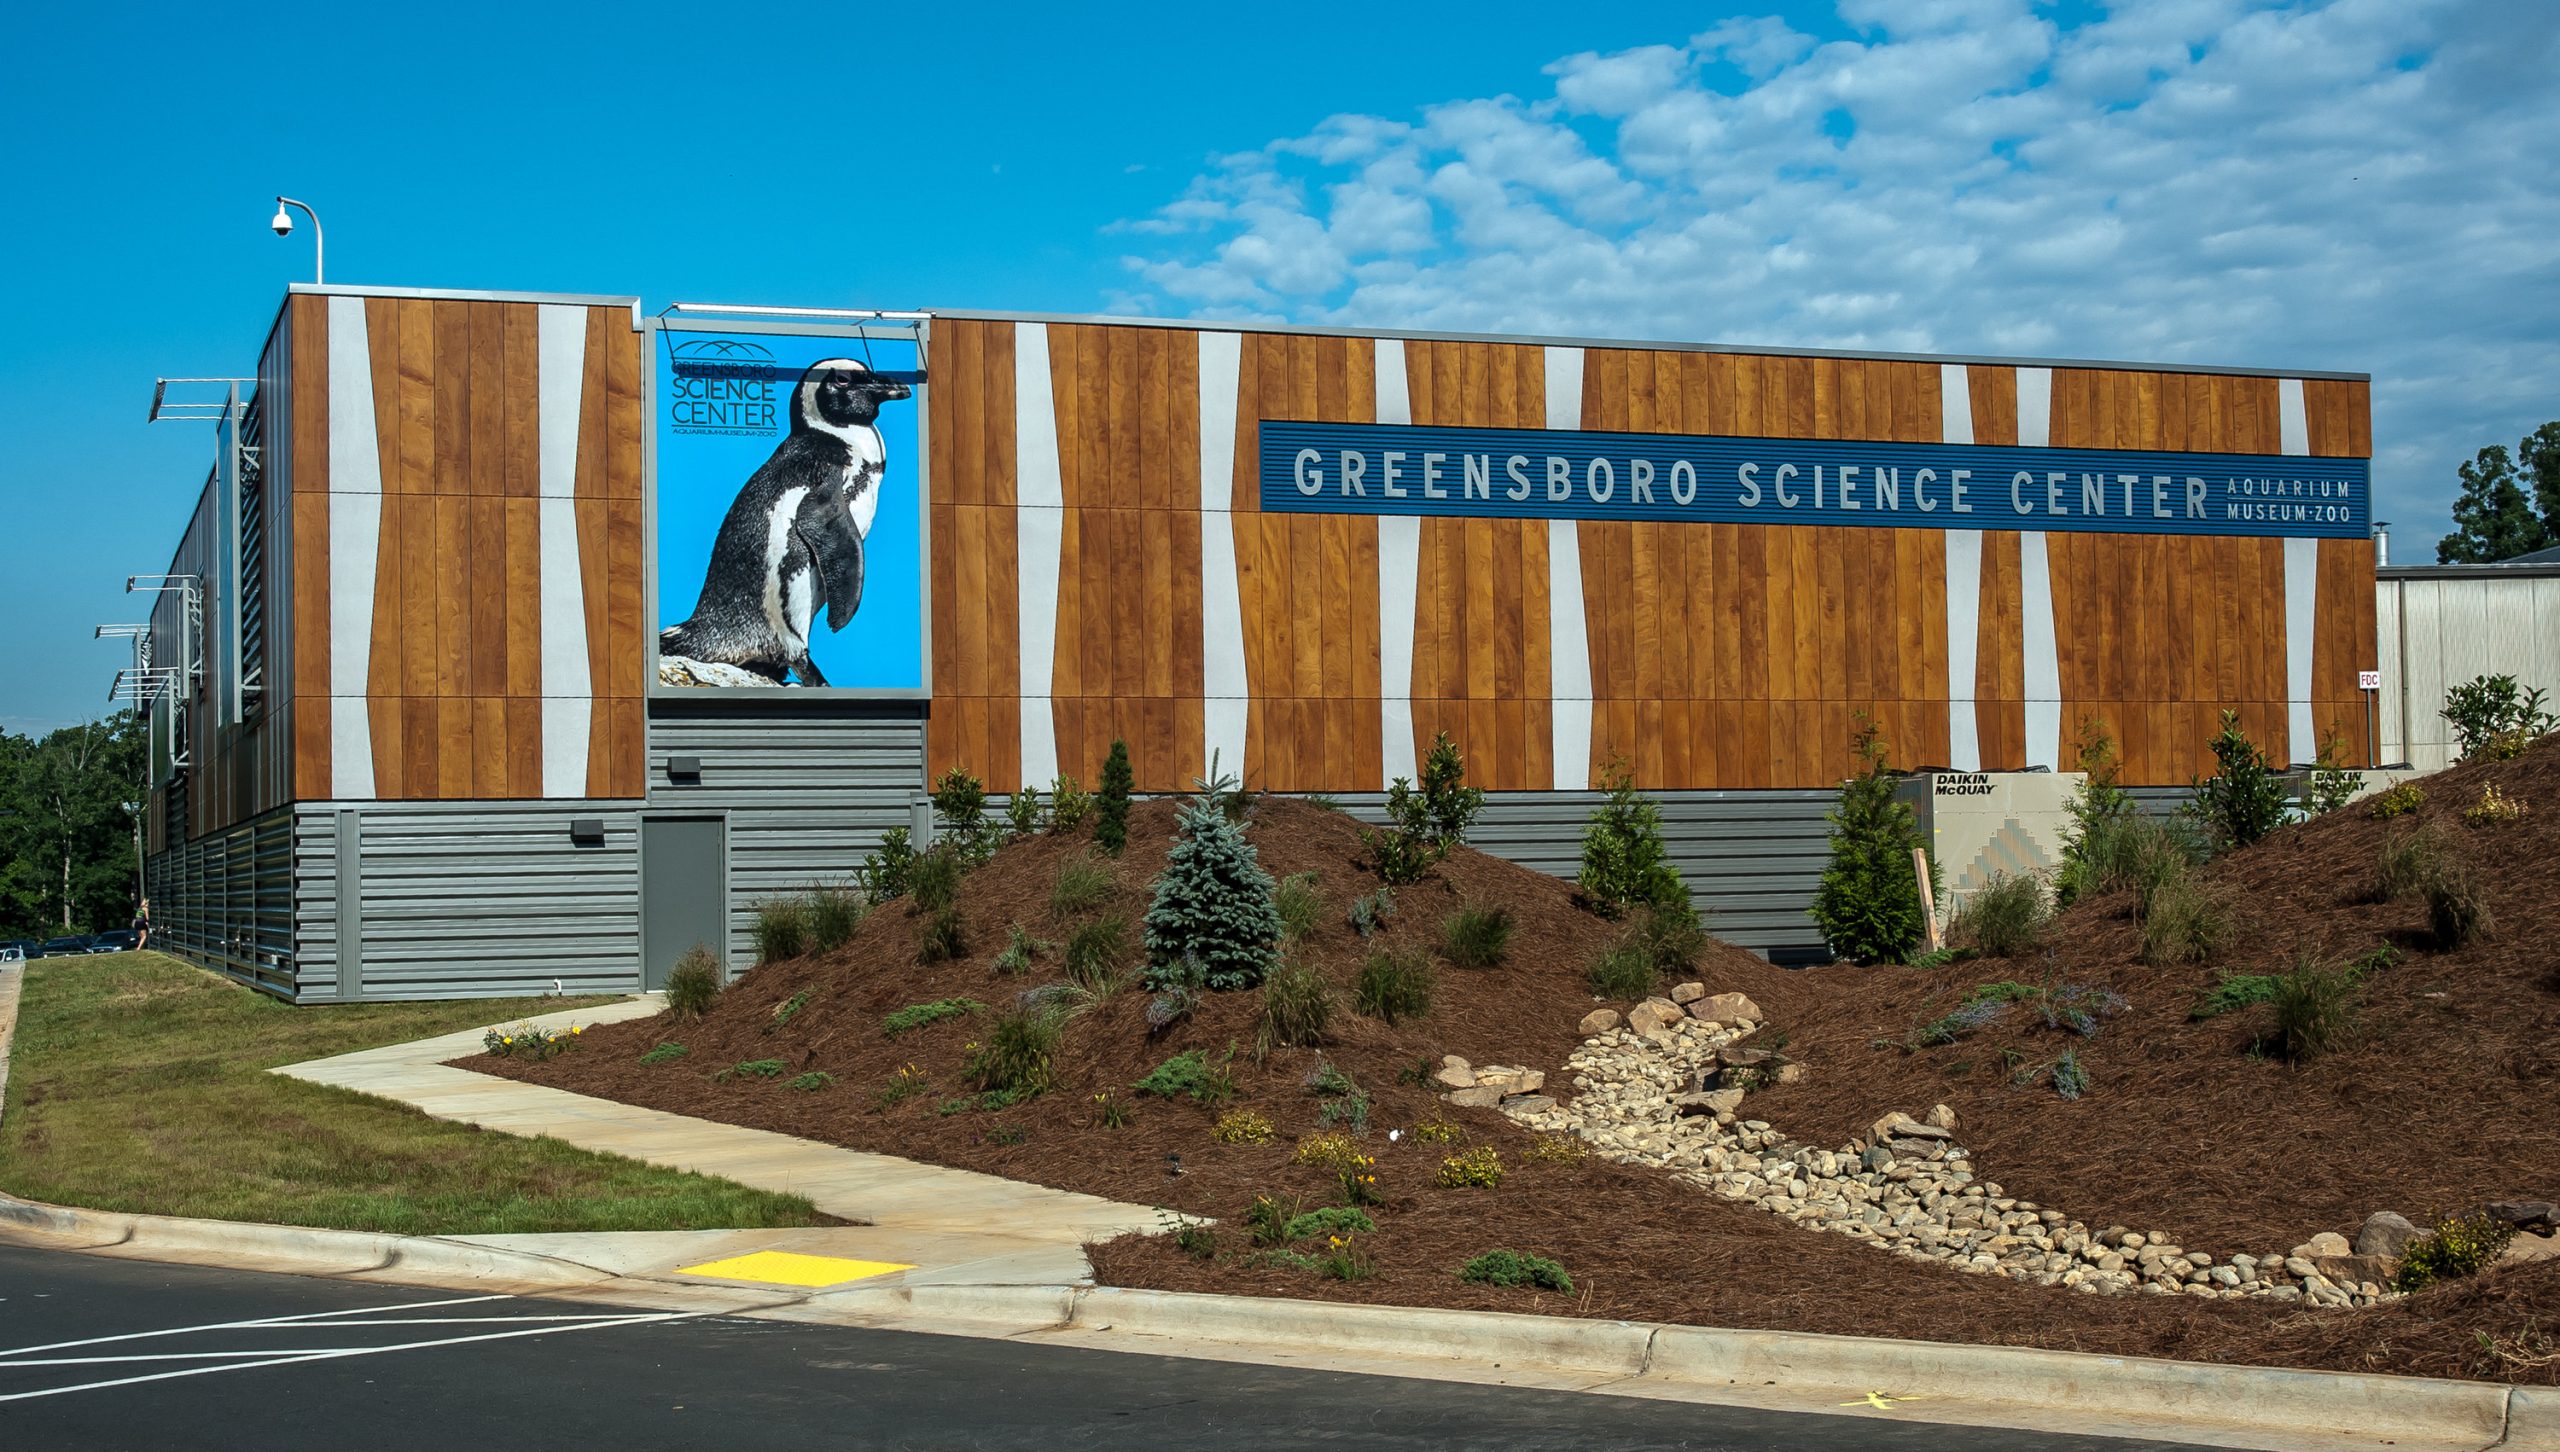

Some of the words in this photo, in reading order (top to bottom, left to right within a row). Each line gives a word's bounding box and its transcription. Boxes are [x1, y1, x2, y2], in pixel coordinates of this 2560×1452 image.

[671, 361, 776, 378] GREENSBORO
[672, 378, 776, 401] SCIENCE
[672, 401, 776, 426] CENTER
[1294, 448, 1697, 505] GREENSBORO
[1738, 462, 1973, 513] SCIENCE
[2011, 471, 2208, 519] CENTER
[2227, 478, 2349, 498] AQUARIUM
[2361, 674, 2378, 686] FDC
[1937, 775, 1988, 784] DAIKIN
[1935, 785, 1995, 795] McQUAY
